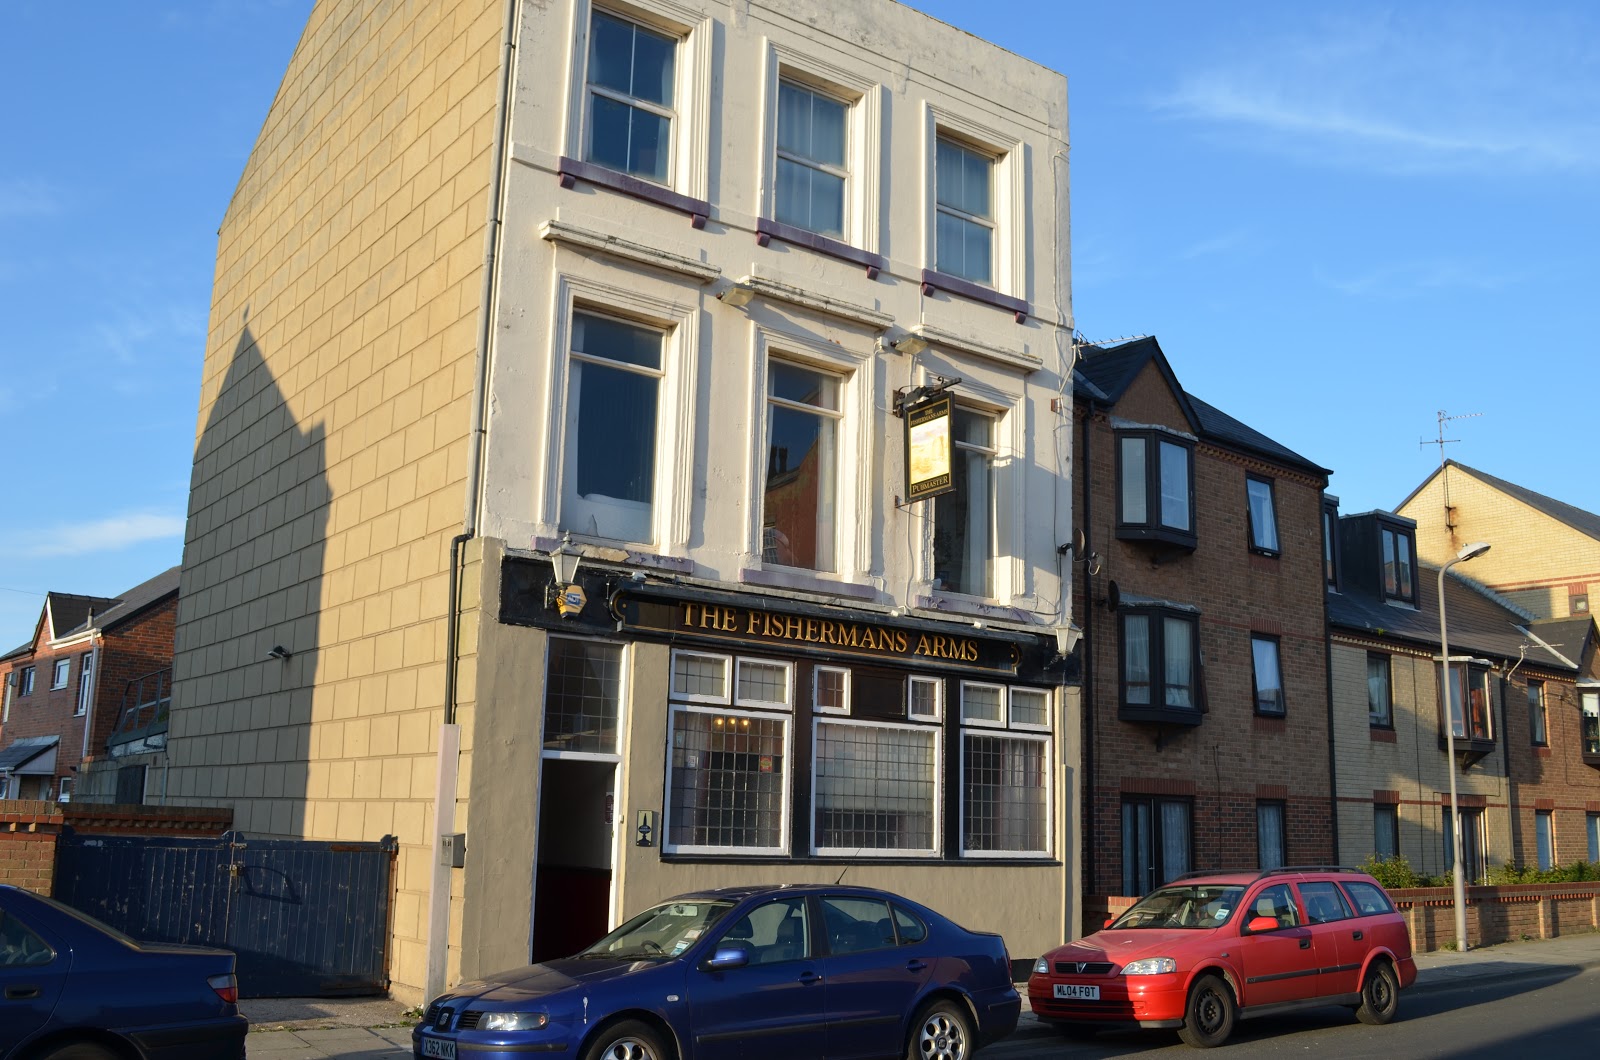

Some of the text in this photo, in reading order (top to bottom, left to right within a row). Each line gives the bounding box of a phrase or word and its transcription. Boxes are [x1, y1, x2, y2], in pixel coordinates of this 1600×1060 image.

[912, 476, 949, 493] PUBMASTER
[679, 602, 978, 662] THE FISHERMANS ARMS
